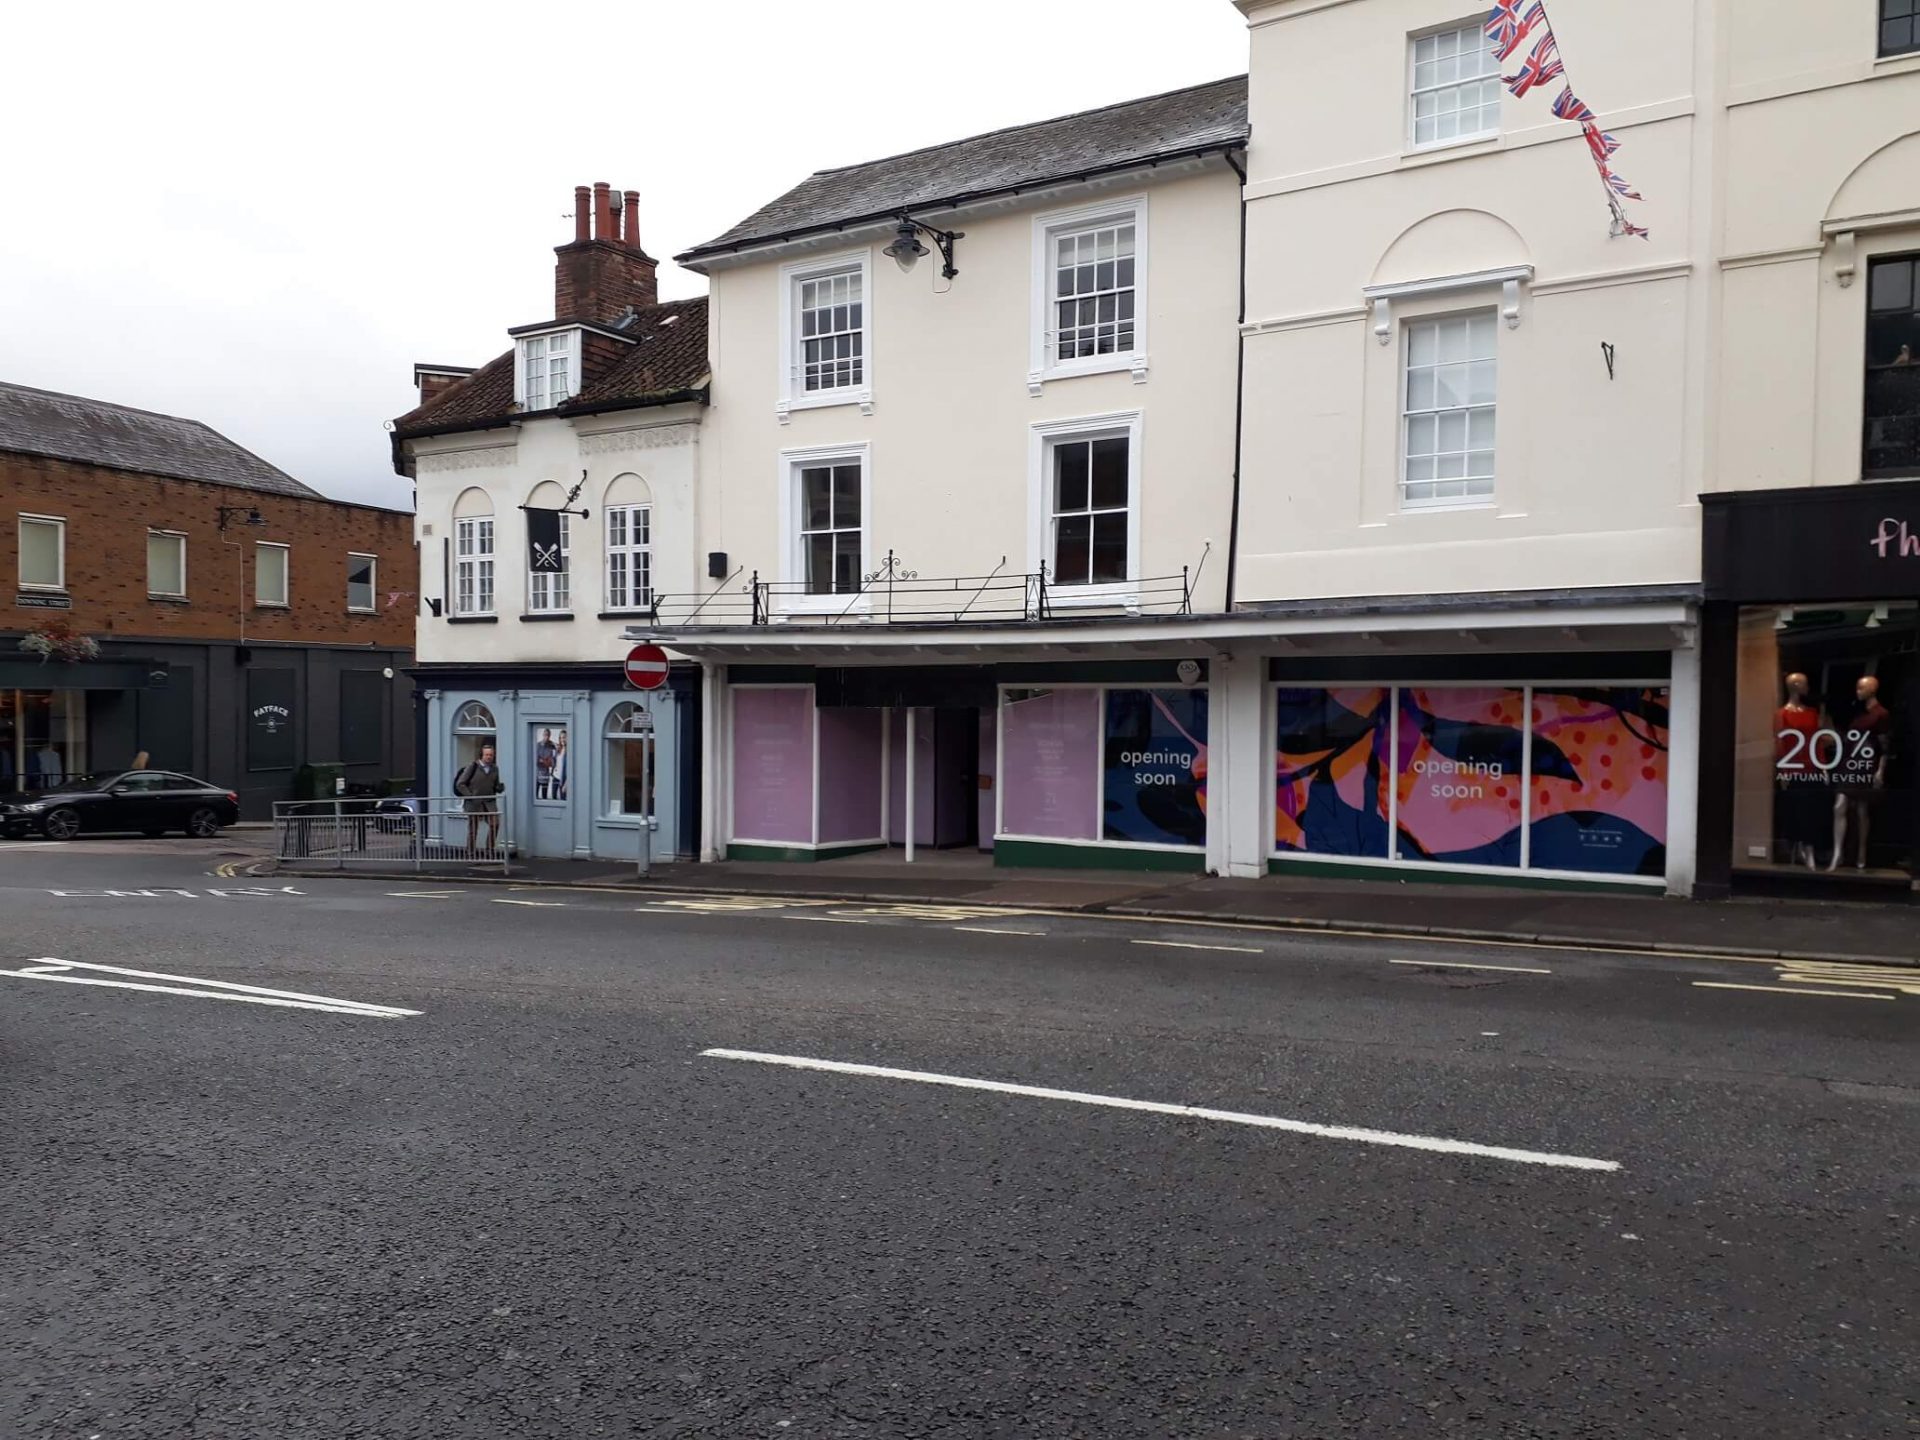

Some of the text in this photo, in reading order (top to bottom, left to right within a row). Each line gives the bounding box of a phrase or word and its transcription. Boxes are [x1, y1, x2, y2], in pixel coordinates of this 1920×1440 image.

[1776, 728, 1875, 770] 20%
[1120, 747, 1191, 769] opening
[1846, 760, 1874, 770] OFF
[1413, 755, 1503, 780] opening
[1134, 772, 1176, 785] soon
[1776, 771, 1873, 783] AUTUMN EVENT
[1431, 784, 1483, 799] soon
